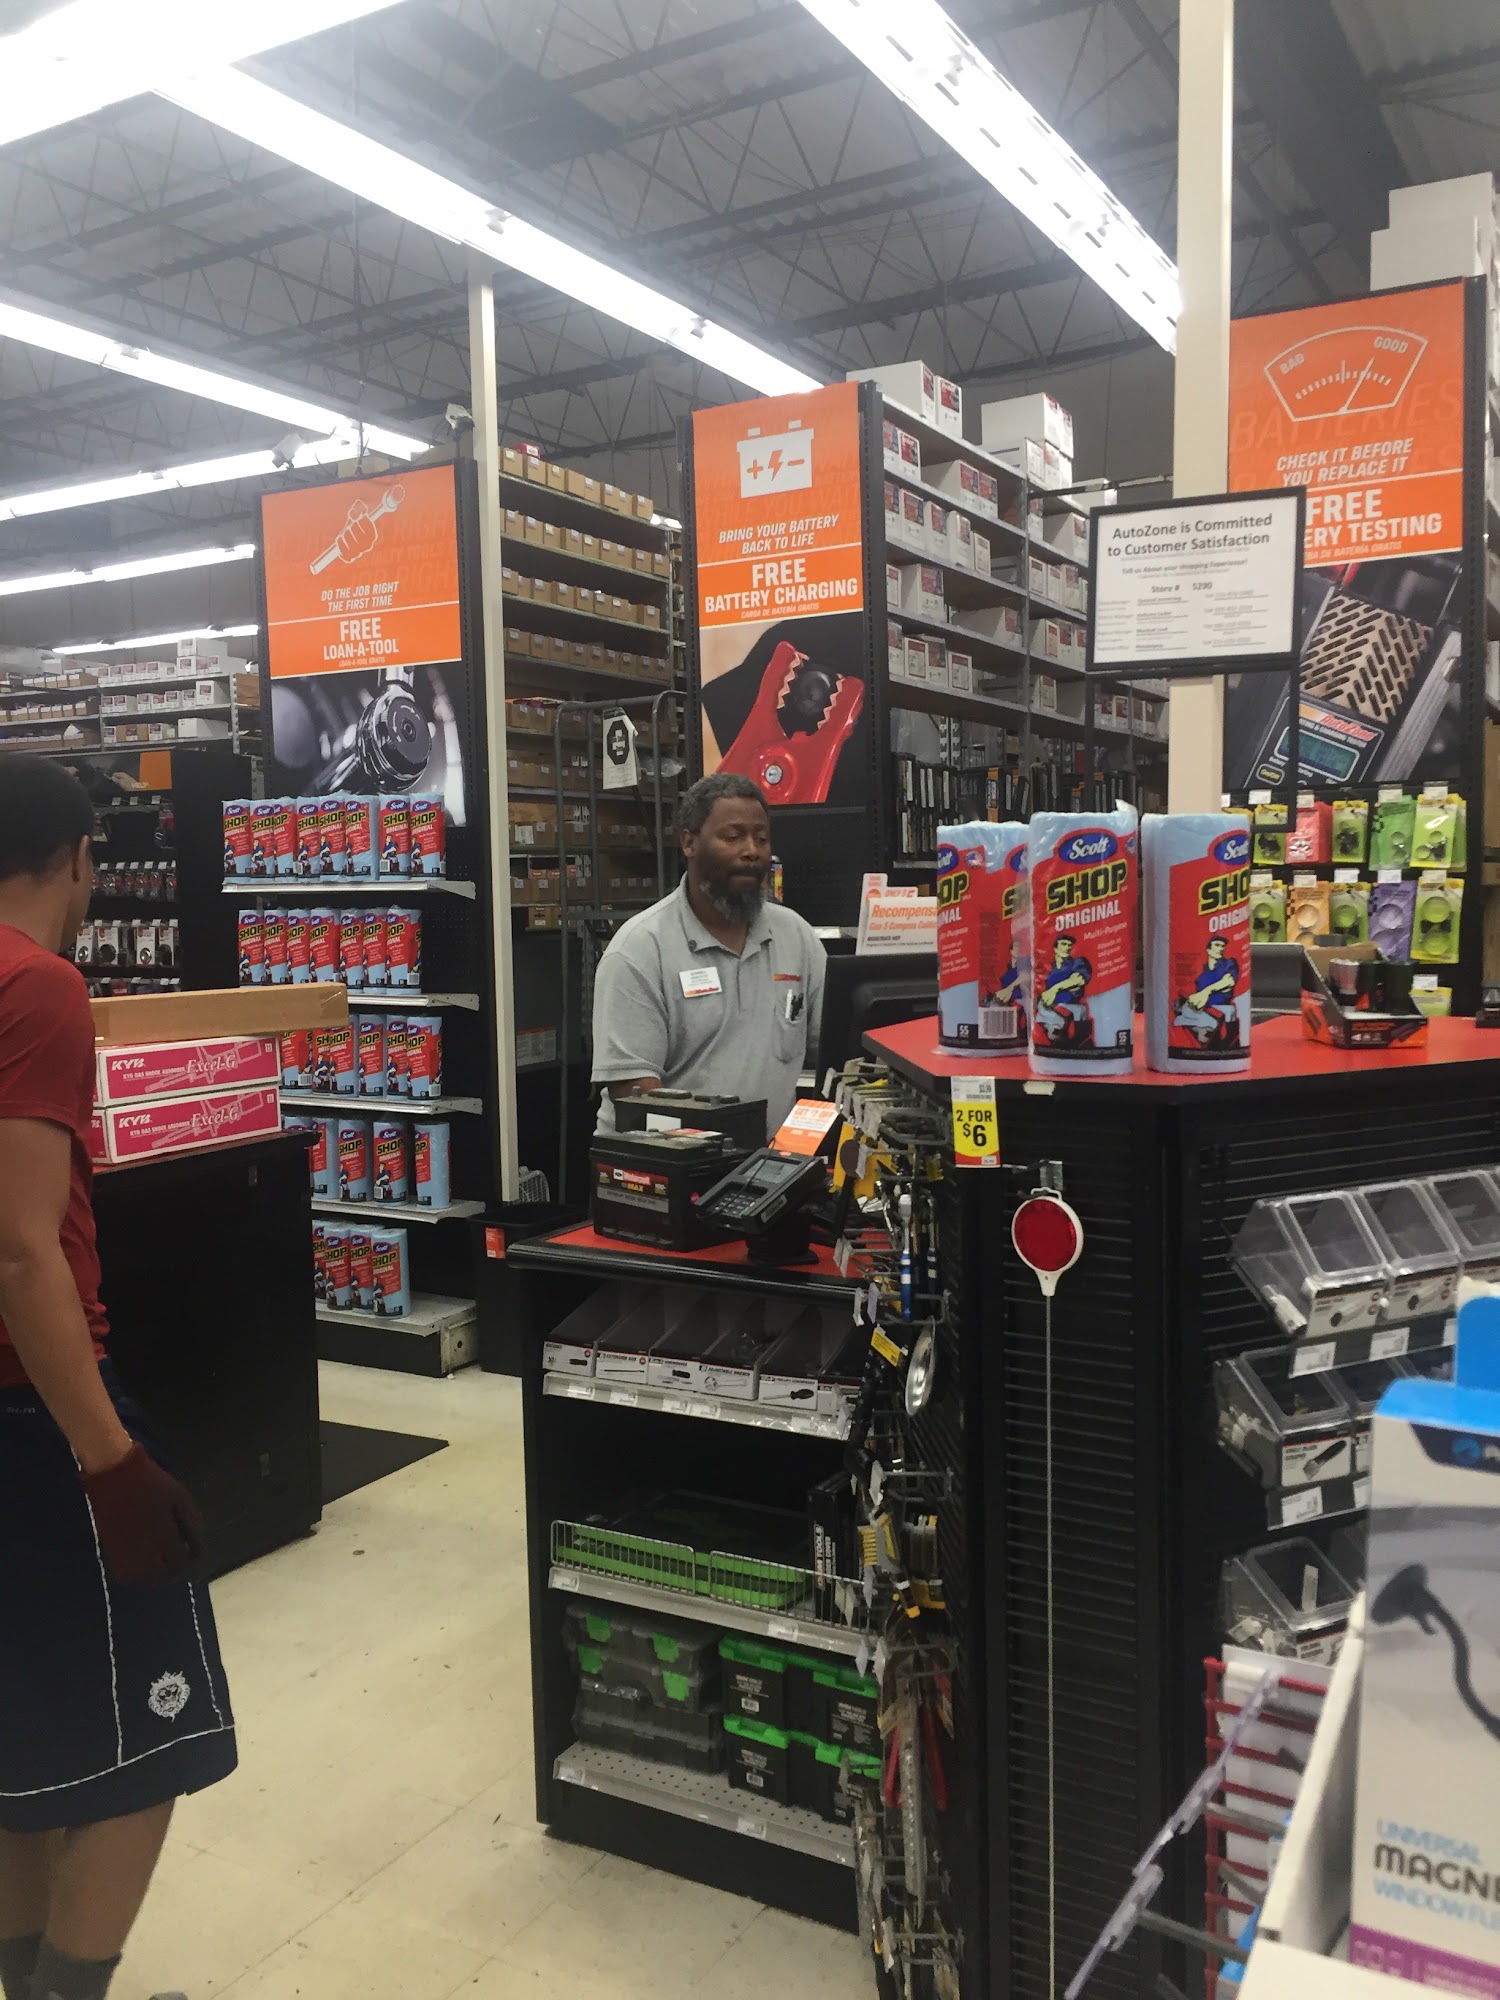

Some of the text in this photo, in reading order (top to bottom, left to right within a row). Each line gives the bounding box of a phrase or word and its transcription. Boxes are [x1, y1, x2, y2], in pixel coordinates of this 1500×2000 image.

[1374, 336, 1408, 354] GOOD
[1279, 352, 1305, 375] BAD
[1276, 437, 1414, 471] CHECK IT BEFORE
[1282, 470, 1313, 488] YOU
[1317, 459, 1387, 482] REPLACE
[1392, 456, 1408, 472] IT
[1305, 488, 1382, 526] FREE
[719, 514, 840, 544] BRING YOUR BATTERY
[1112, 513, 1273, 540] AutoZone is Committed
[1304, 512, 1442, 548] ERY TESTING
[742, 532, 815, 555] BACK TO LIFE
[1107, 546, 1121, 557] to
[1124, 538, 1188, 555] Customer
[1191, 533, 1270, 550] Satisfaction
[752, 558, 806, 588] FREE
[321, 581, 399, 601] DO THE JOB RIGHT
[705, 578, 858, 613] BATTERY CHARGING
[328, 595, 393, 613] THE FIRST TIME
[340, 617, 382, 642] FREE
[323, 638, 399, 660] LOAN-A-TOOL
[1320, 714, 1375, 742] AutoZone
[1069, 836, 1110, 860] Scott
[938, 872, 969, 907] OP
[1047, 860, 1127, 912] SHOP
[1200, 869, 1250, 912] SHO
[1055, 900, 1121, 931] ORIGINAL
[265, 925, 284, 937] HOP
[364, 924, 382, 936] HOP
[360, 1034, 379, 1046] HOP
[959, 1026, 969, 1035] 55
[1119, 1031, 1127, 1046] 55
[111, 1058, 144, 1071] KYB
[186, 1054, 236, 1074] Excel-G
[119, 1114, 151, 1128] KYB
[192, 1107, 239, 1127] Excel-G
[956, 1110, 992, 1122] 2 FOR
[962, 1122, 987, 1147] $6
